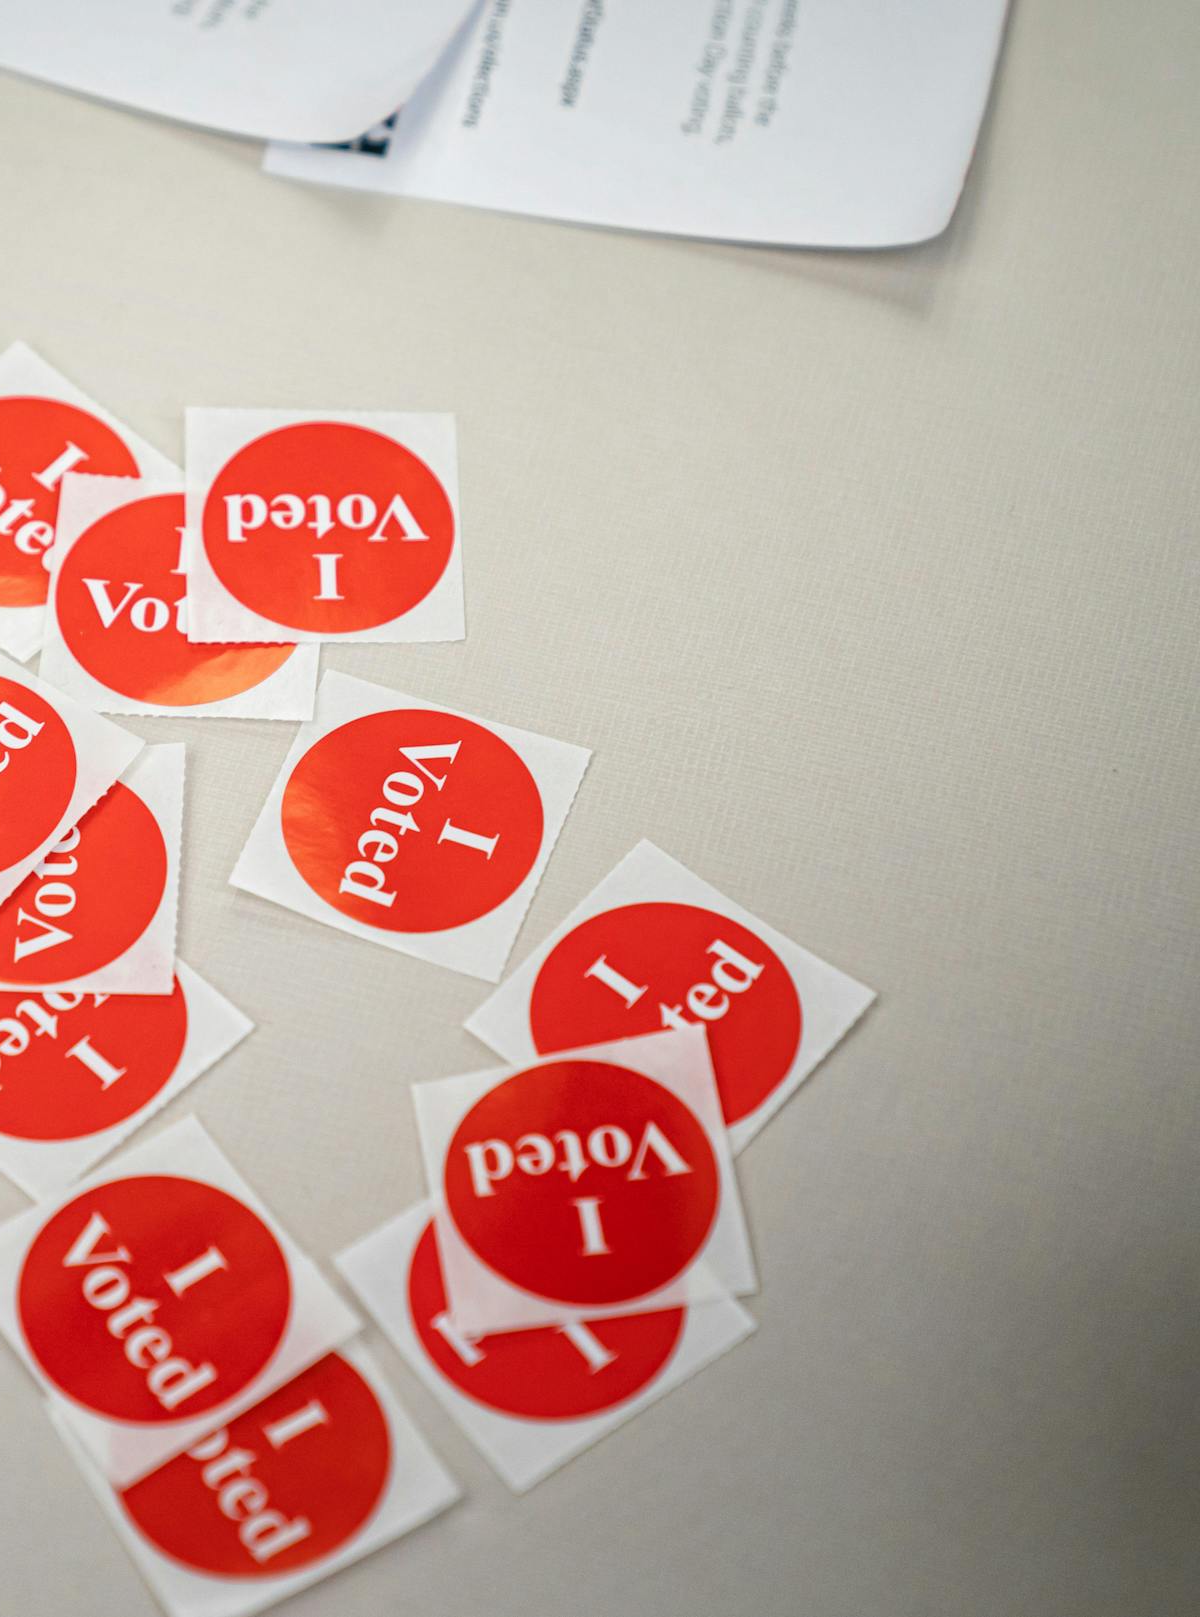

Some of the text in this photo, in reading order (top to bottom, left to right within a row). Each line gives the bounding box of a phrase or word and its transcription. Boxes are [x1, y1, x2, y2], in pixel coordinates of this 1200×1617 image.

[31, 440, 90, 492] I
[223, 493, 430, 543] Voted
[311, 552, 344, 601] I
[81, 577, 189, 635] Vot
[337, 739, 462, 909] Voted
[436, 816, 500, 862] I
[13, 825, 82, 963] Vote
[583, 953, 649, 1010] I
[658, 938, 766, 1031] ted
[65, 1034, 128, 1092] I
[463, 1120, 695, 1199] Voted
[571, 1196, 614, 1257] I
[162, 1245, 229, 1299] I
[62, 1210, 220, 1412] Voted
[261, 1398, 330, 1450] I
[185, 1425, 312, 1563] oted
